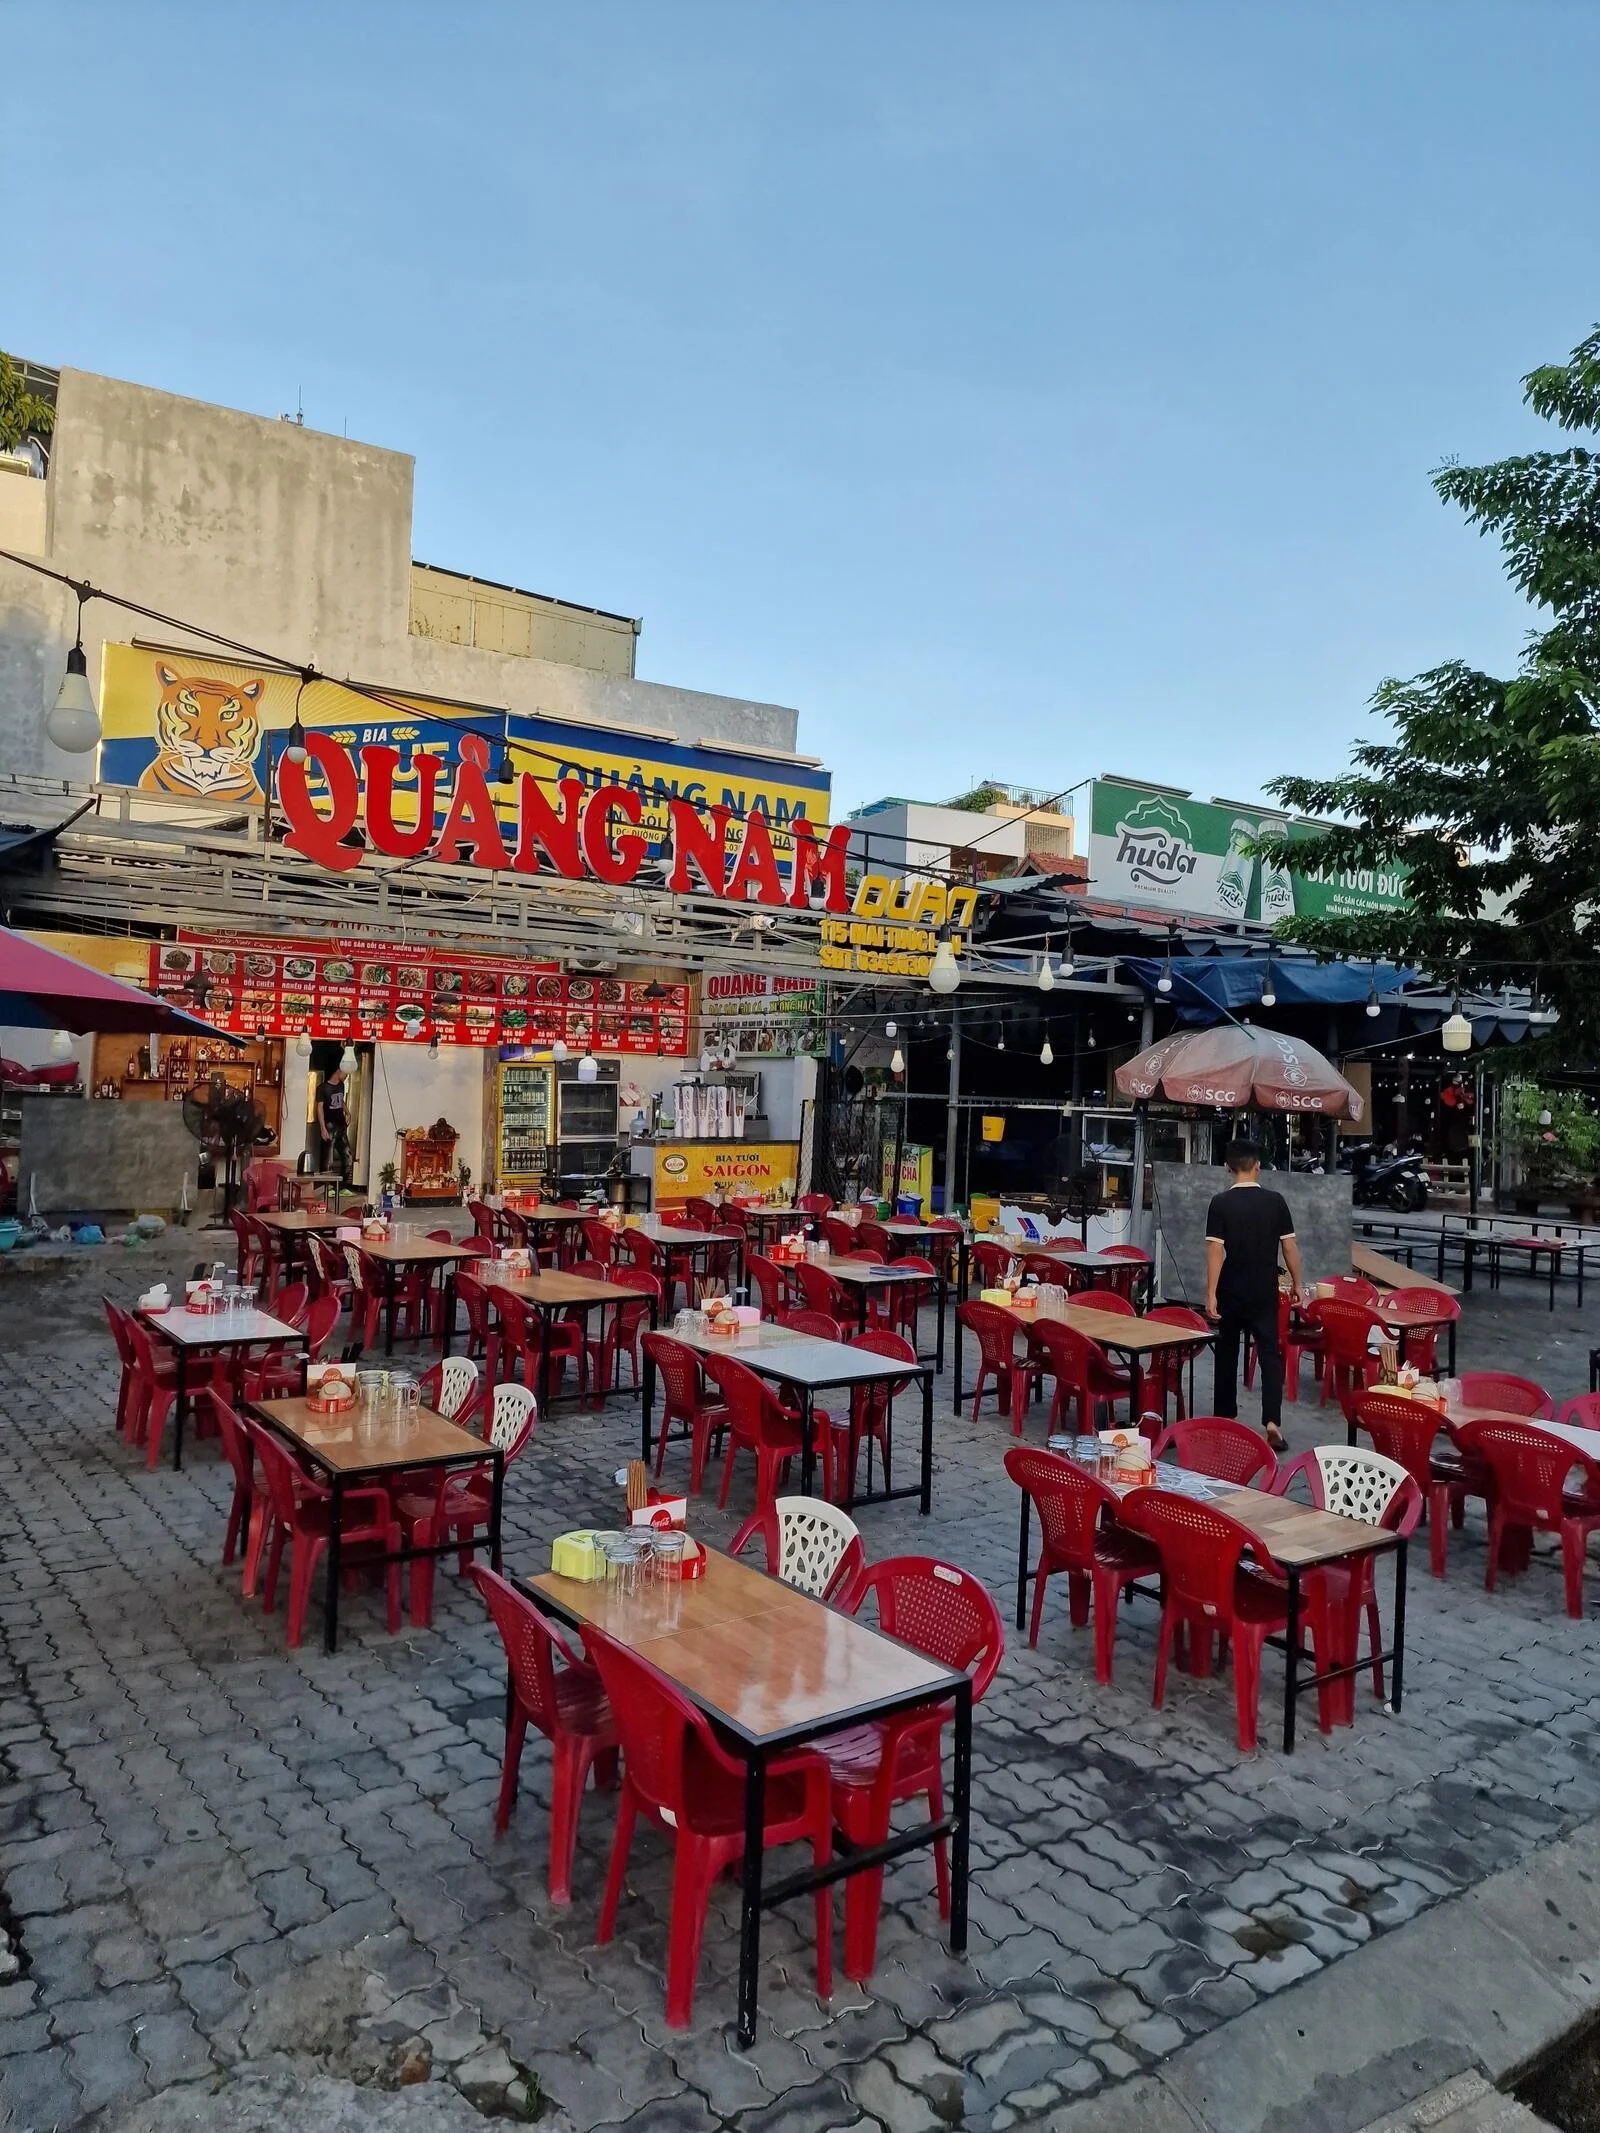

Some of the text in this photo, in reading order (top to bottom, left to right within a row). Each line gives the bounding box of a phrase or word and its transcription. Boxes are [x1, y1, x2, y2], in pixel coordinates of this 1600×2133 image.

[362, 727, 388, 743] BIA
[721, 787, 807, 830] NAM
[276, 731, 852, 913] QUẢNG NAM
[1116, 829, 1198, 875] huda
[1134, 884, 1158, 893] PREMIUM
[819, 919, 848, 943] 115
[850, 922, 885, 947] MAI
[928, 931, 962, 955] LN
[1205, 1088, 1237, 1103] SCG
[1292, 1095, 1323, 1109] SCG
[715, 1152, 760, 1163] BIA TƯƠI
[702, 1163, 772, 1178] SAIGON
